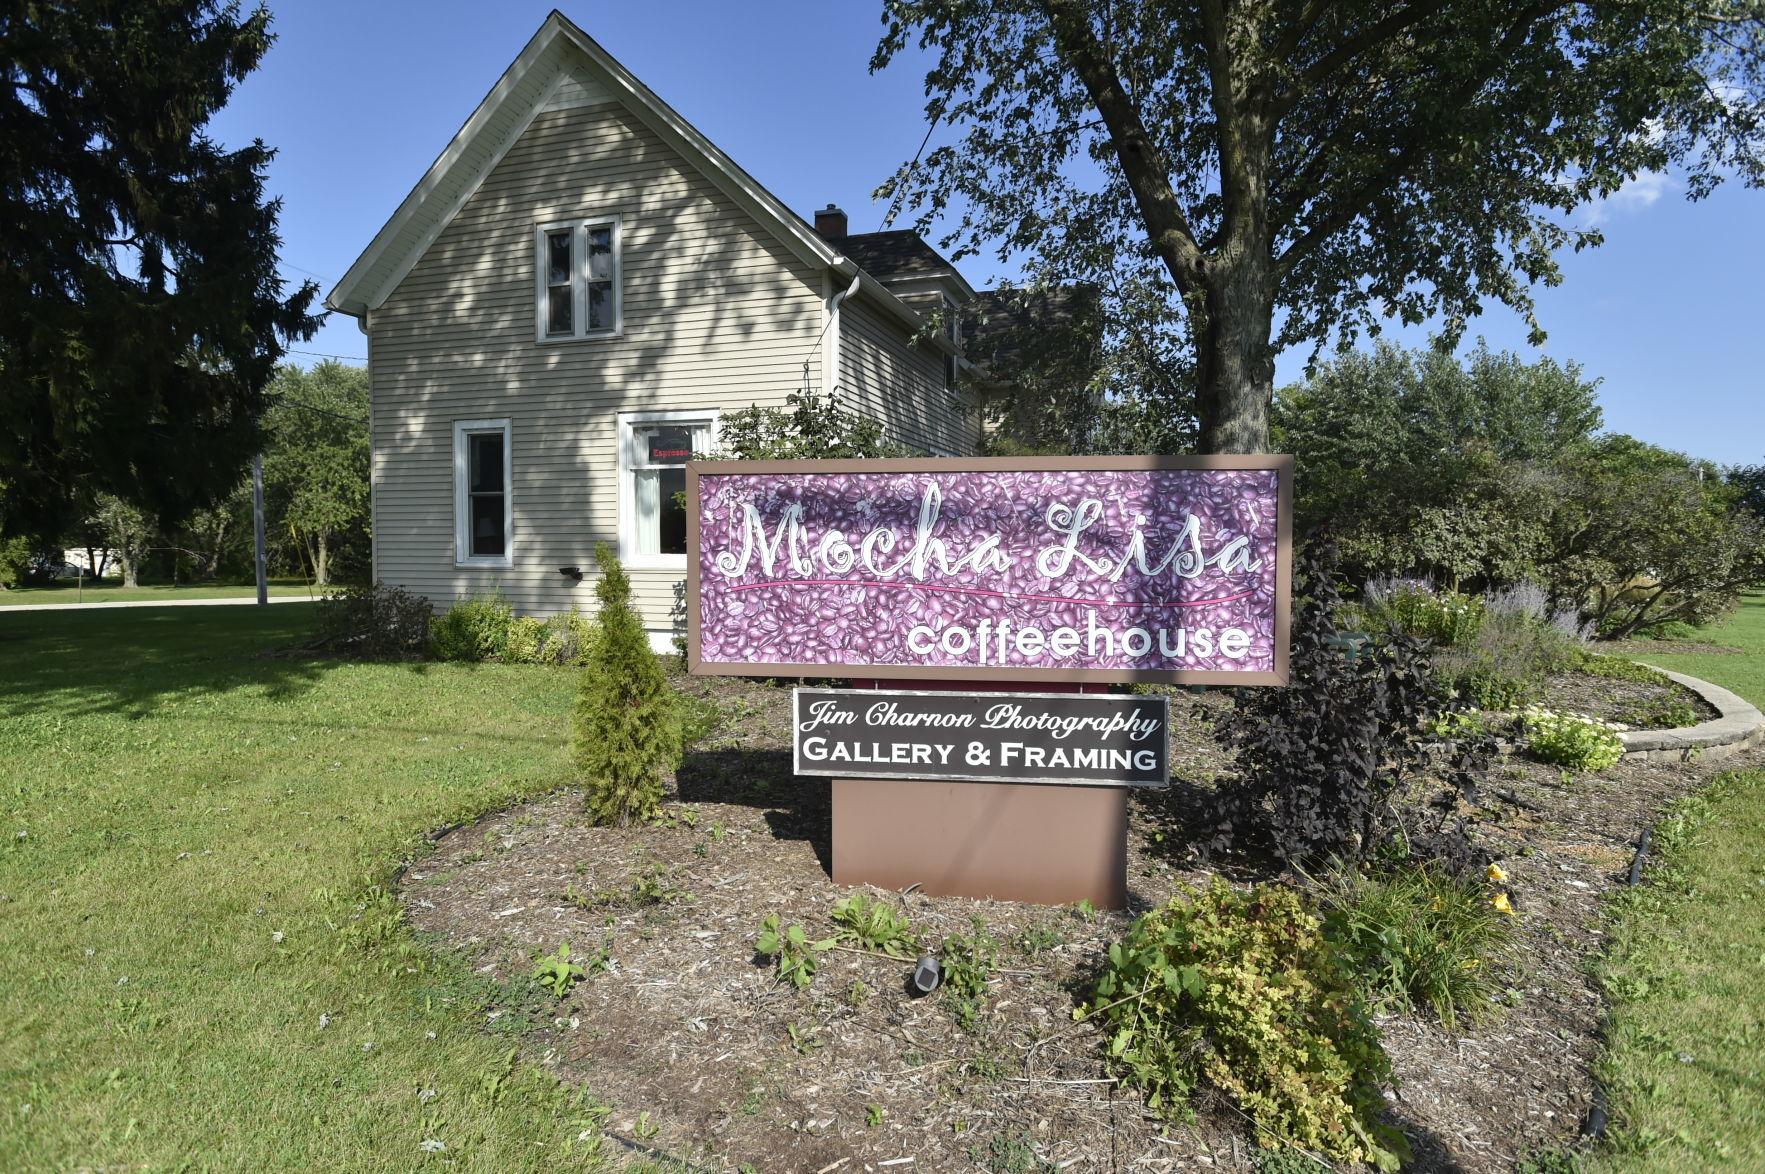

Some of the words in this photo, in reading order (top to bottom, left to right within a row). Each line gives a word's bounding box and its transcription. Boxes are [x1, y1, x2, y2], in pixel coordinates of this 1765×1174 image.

[652, 449, 689, 458] Espresso
[717, 481, 1013, 581] Mocha
[1036, 500, 1262, 582] Lisa
[907, 610, 1251, 664] coffeehouse
[800, 700, 858, 732] Jim
[865, 702, 976, 727] Charnon
[980, 704, 1160, 740] Photography
[803, 737, 955, 765] GALLERY
[965, 742, 990, 765] &
[1000, 742, 1156, 770] FRAMING
